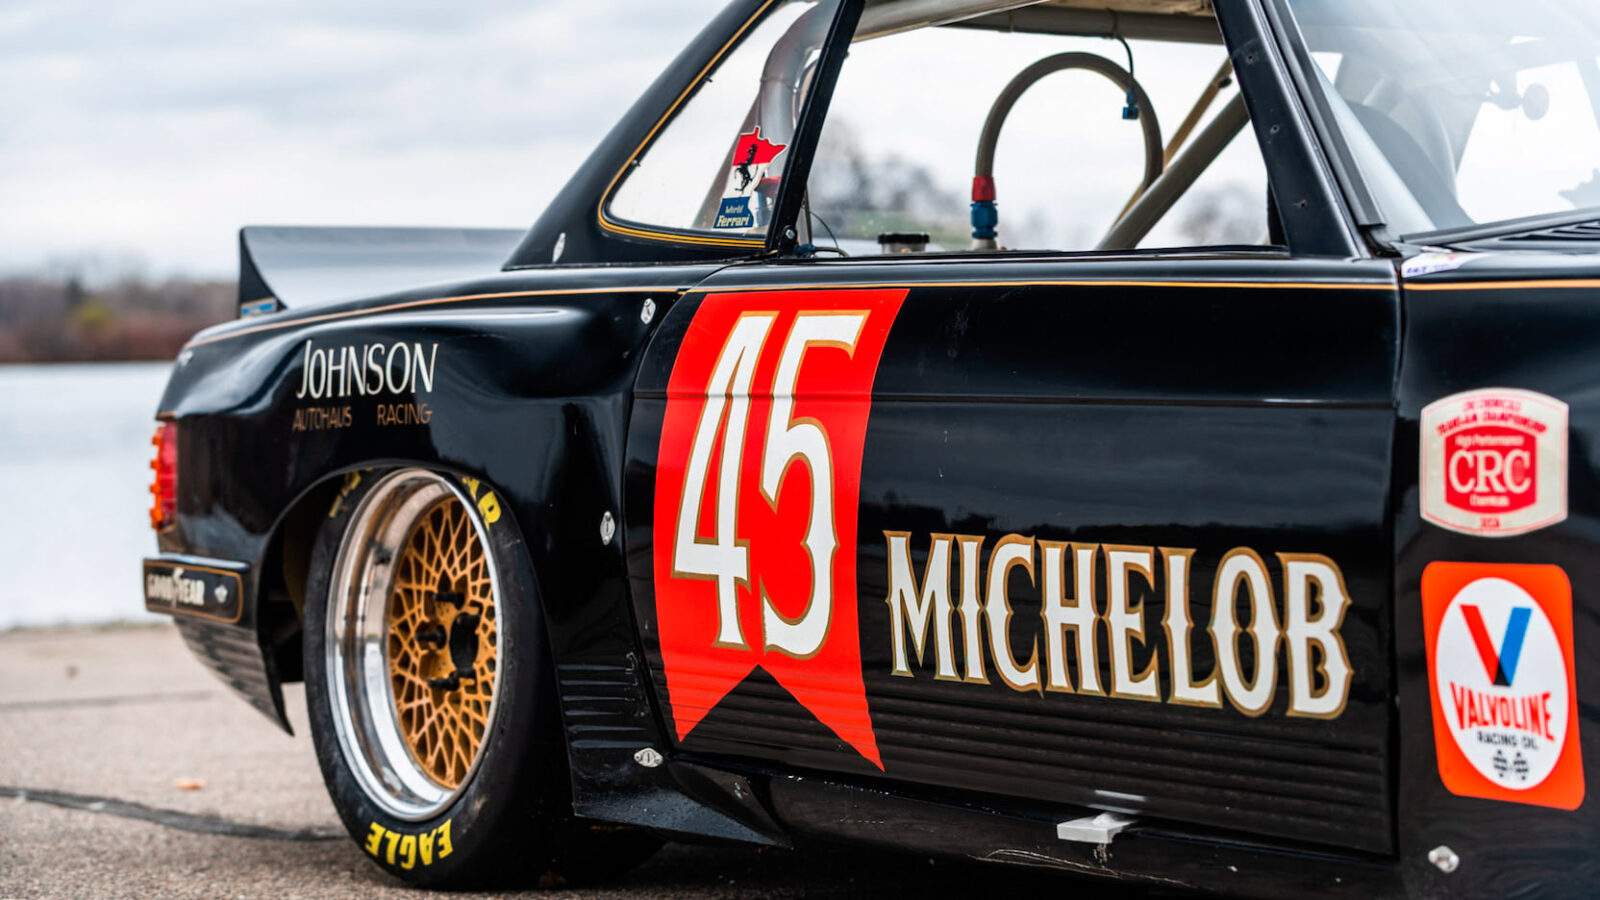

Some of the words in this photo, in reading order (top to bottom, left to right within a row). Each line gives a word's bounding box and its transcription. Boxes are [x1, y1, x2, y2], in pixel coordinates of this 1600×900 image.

[716, 214, 750, 226] Ferrari
[296, 339, 438, 399] JOHNSON
[292, 406, 353, 431] AUTOHAUS
[376, 403, 433, 426] RACING
[671, 310, 871, 660] 45
[1450, 448, 1531, 494] CRC
[882, 530, 1354, 720] MICHELOB
[1450, 681, 1555, 742] VALVOLINE
[1477, 731, 1517, 747] RACING
[1521, 734, 1539, 750] OIL
[365, 818, 454, 870] EAGLE
